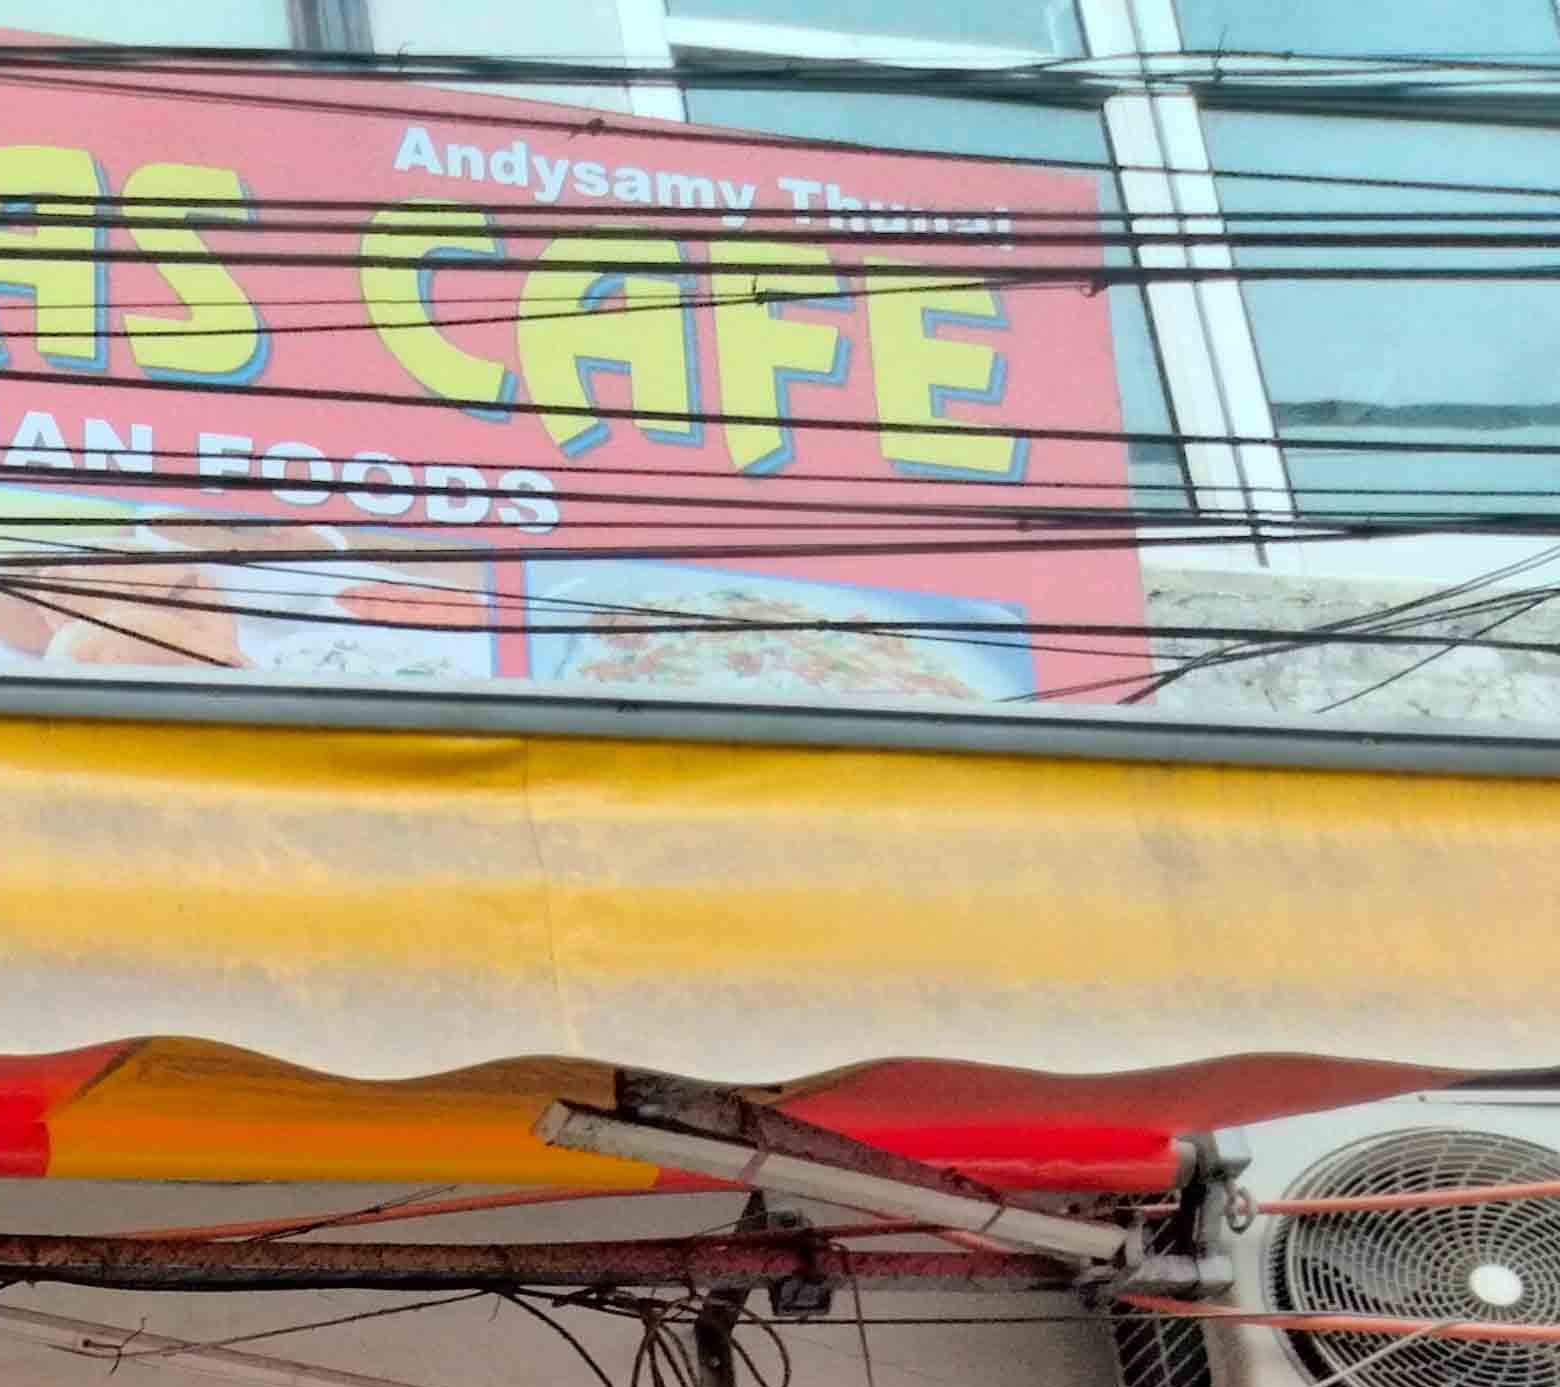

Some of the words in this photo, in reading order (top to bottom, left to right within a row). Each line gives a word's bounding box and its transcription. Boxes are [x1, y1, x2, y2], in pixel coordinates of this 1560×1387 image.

[393, 127, 759, 228] Andysamy
[358, 198, 1028, 483] CAFE
[197, 432, 561, 534] FOODS
